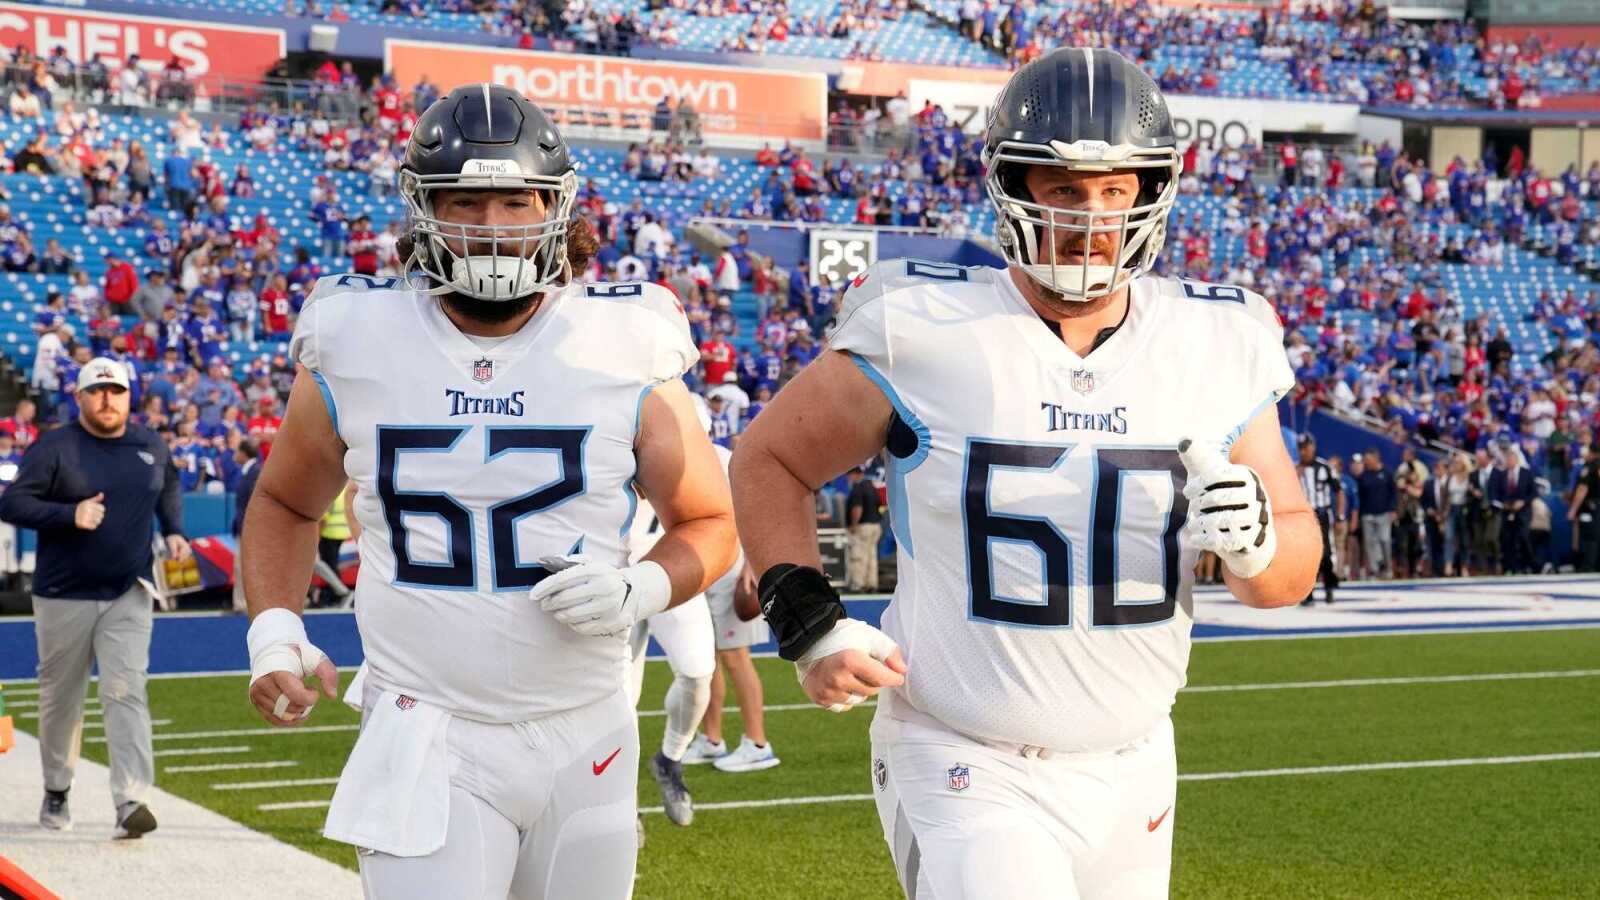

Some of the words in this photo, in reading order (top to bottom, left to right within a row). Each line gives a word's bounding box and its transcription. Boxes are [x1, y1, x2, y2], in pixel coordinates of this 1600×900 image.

[493, 61, 738, 110] northtown
[819, 239, 867, 281] 25
[445, 388, 525, 417] TITANS
[1040, 401, 1128, 435] TITANS
[375, 424, 594, 593] 62
[961, 437, 1190, 632] 60
